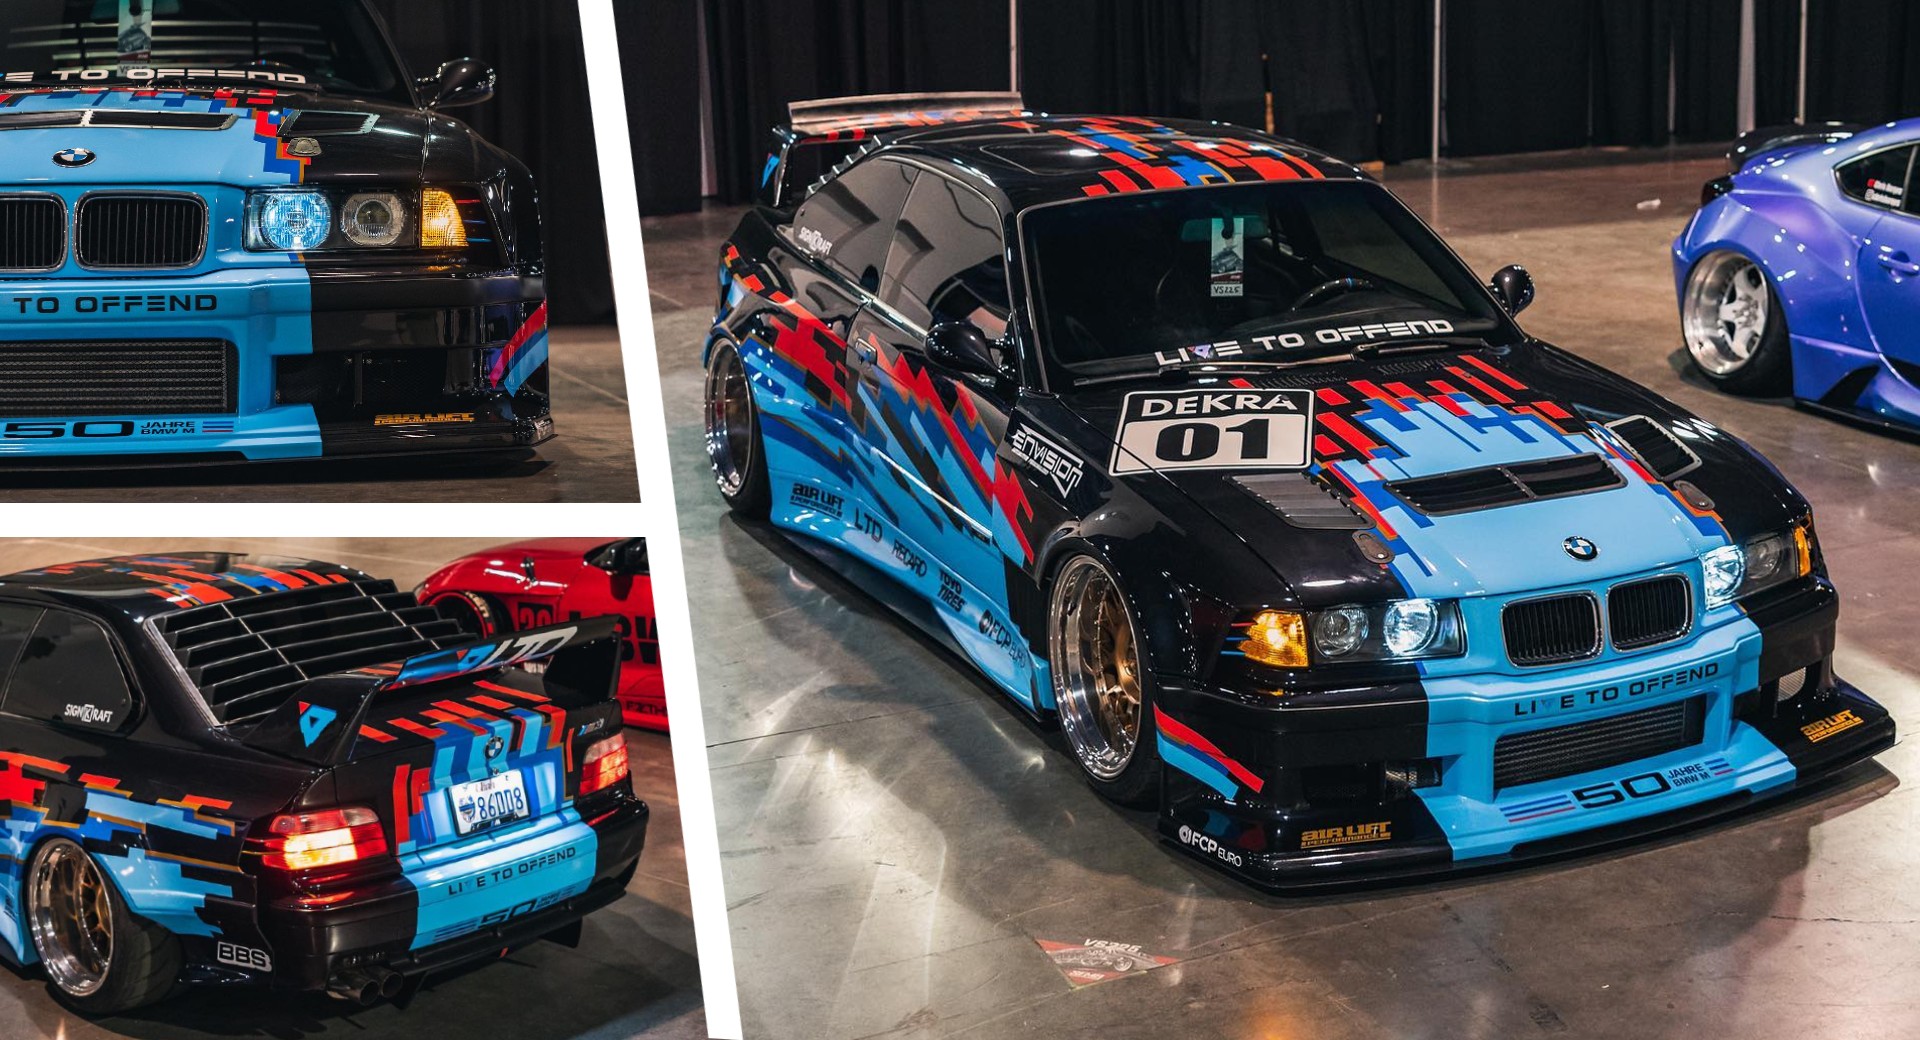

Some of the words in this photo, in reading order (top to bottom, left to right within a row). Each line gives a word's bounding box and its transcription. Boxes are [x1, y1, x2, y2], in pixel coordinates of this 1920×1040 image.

[52, 69, 109, 81] TO
[126, 68, 306, 84] OFFEND
[13, 297, 60, 314] TO
[75, 294, 218, 313] OFFEND
[1252, 332, 1305, 351] TO
[1315, 319, 1454, 343] OFFEND
[1141, 394, 1298, 417] DEKRA
[3, 421, 135, 439] 50
[141, 421, 196, 429] JAHRE
[1155, 418, 1270, 462] 01
[821, 490, 845, 510] LIFT
[854, 507, 882, 543] LTD
[891, 540, 927, 578] RECARO
[939, 569, 963, 594] TOYO
[937, 585, 967, 612] TIRES
[479, 626, 578, 671] LTD
[988, 621, 1013, 651] FCP
[1586, 686, 1619, 704] TO
[1629, 662, 1718, 696] OFFEND
[1667, 763, 1705, 779] JAHRE
[1672, 773, 1699, 787] BMW
[1699, 771, 1711, 782] M
[1571, 771, 1671, 809] 50
[1191, 831, 1218, 853] FCP
[1218, 847, 1242, 867] EURO
[491, 868, 513, 883] TO
[518, 847, 576, 874] OFFEND
[218, 942, 269, 969] BBS
